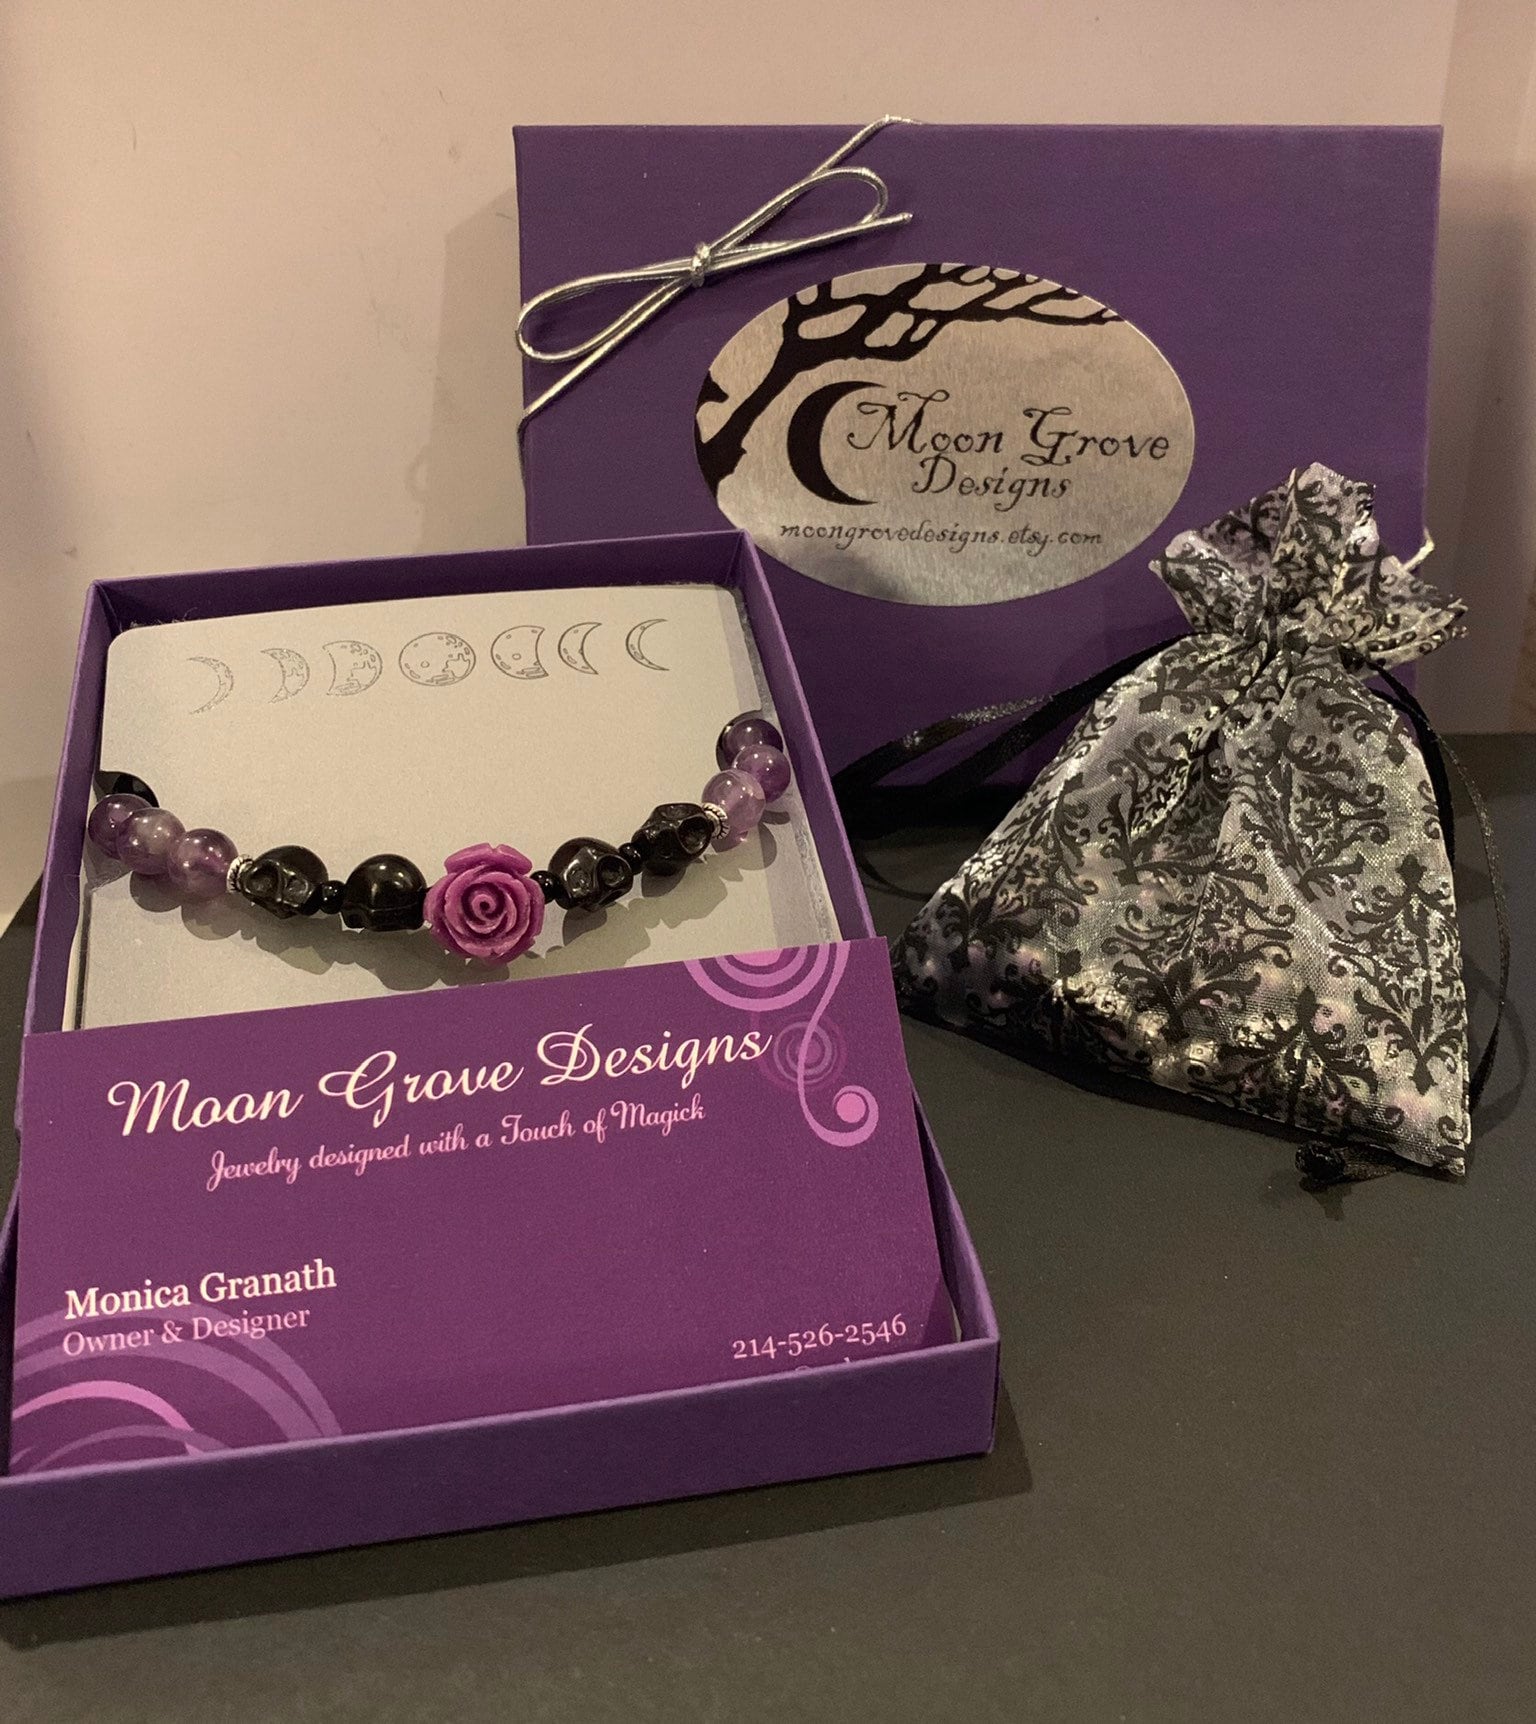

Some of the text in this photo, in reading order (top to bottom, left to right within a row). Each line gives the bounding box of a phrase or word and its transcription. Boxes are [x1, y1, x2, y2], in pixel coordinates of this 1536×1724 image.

[847, 389, 1170, 466] Moon Grove
[912, 455, 1073, 512] Designs
[780, 520, 1102, 556] moongrovedesigns.etsy.com
[107, 1023, 773, 1137] Moon Grove Designs
[206, 1093, 706, 1192] Jewelry designed with a Touch of Magick
[64, 1258, 338, 1320] Monica Granath
[63, 1306, 311, 1357] Owner & Designer
[732, 1313, 907, 1360] 214-526-2546
